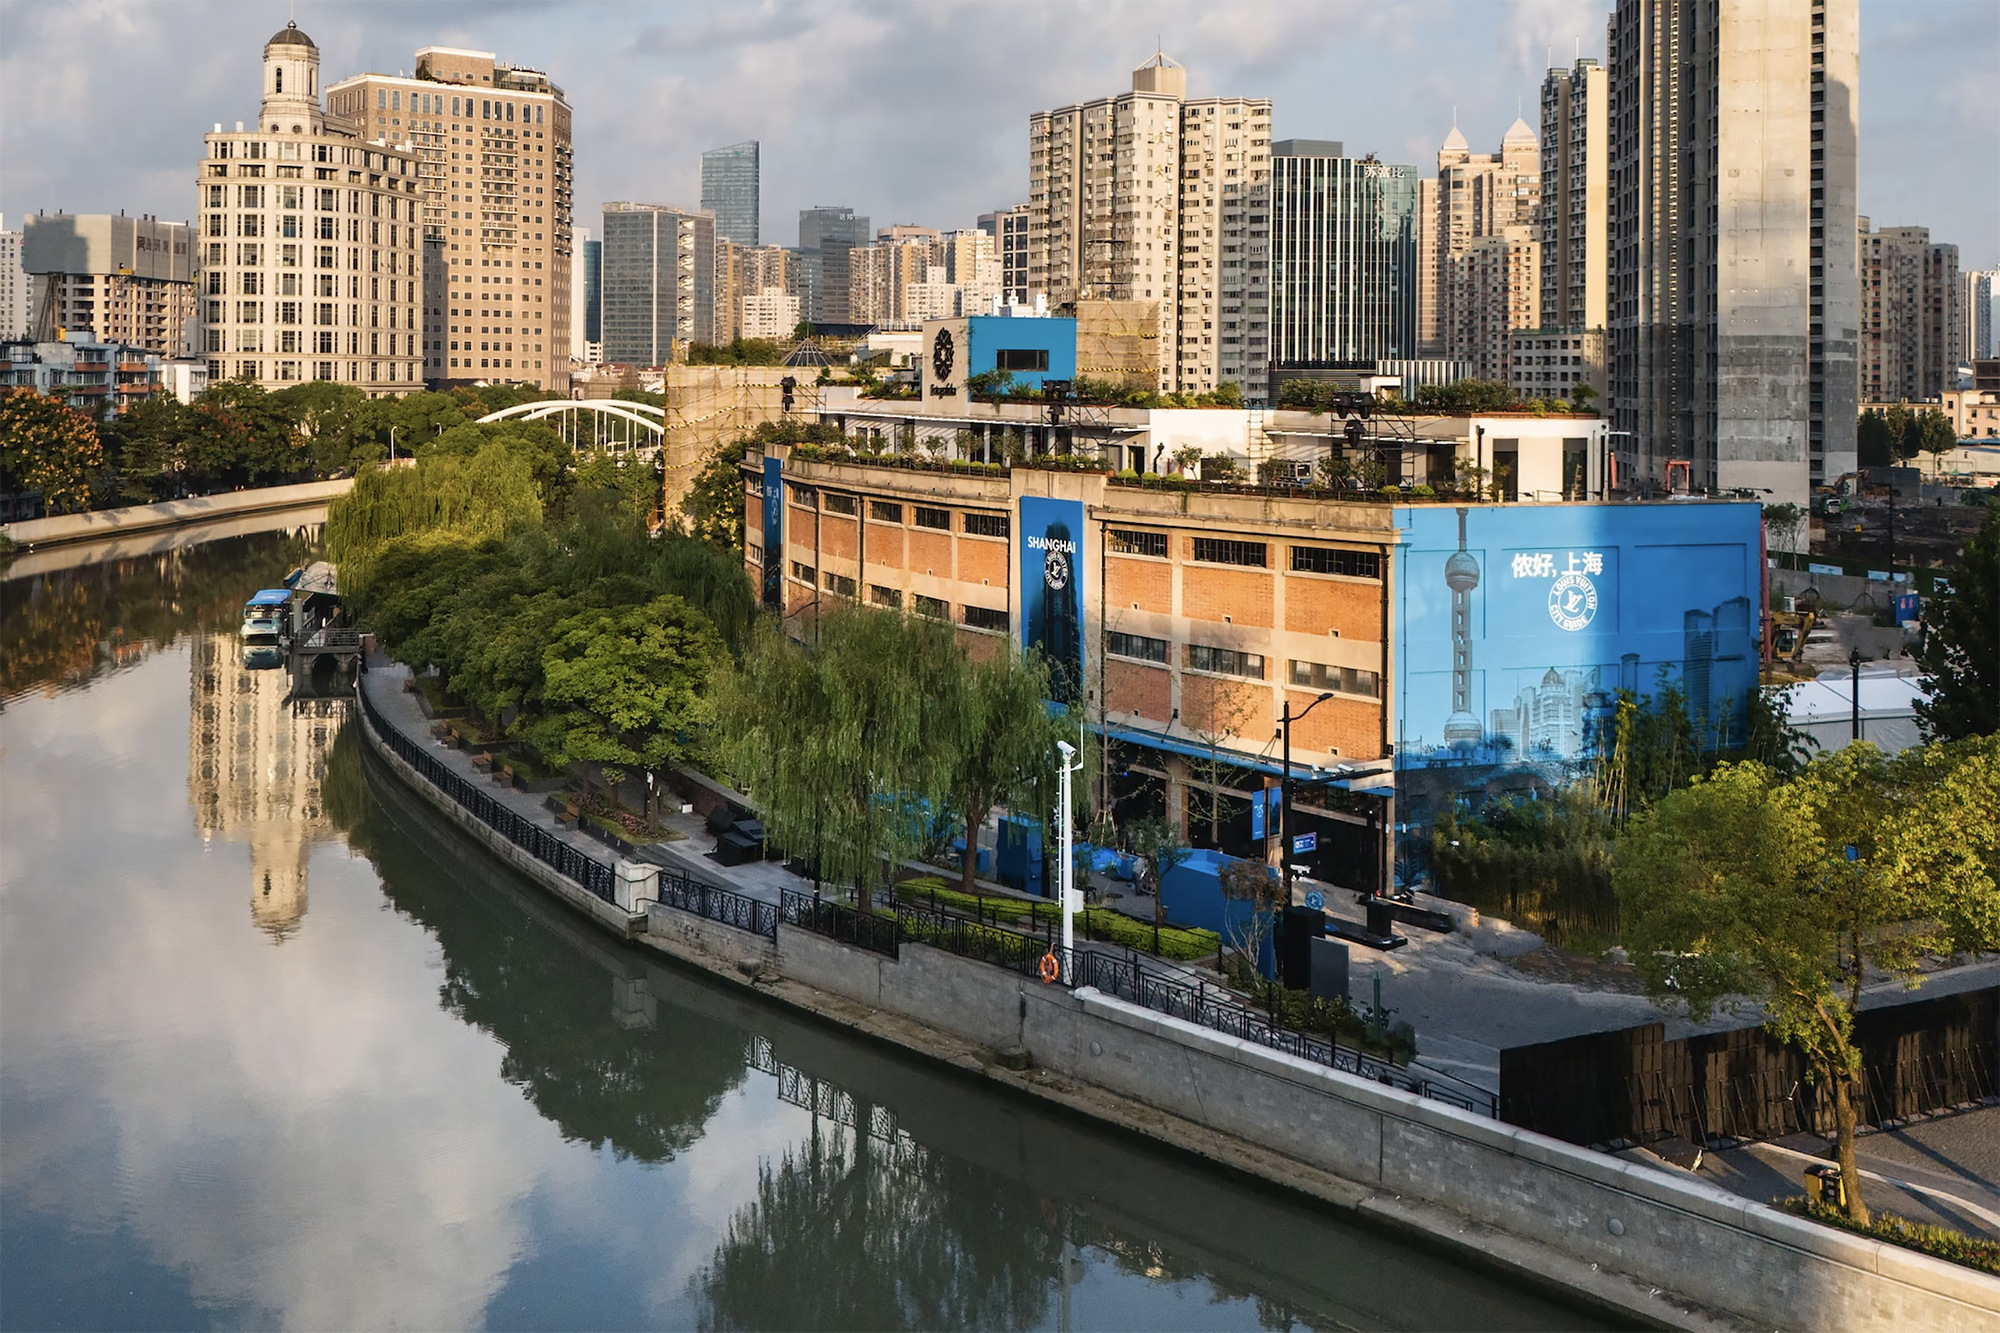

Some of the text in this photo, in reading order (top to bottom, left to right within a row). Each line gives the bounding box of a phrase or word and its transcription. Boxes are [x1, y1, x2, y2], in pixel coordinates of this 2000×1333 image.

[1027, 536, 1076, 553] SHANGHAI
[1552, 575, 1596, 610] LOUIS VUITTON
[1550, 604, 1588, 629] CITY GUIDE
